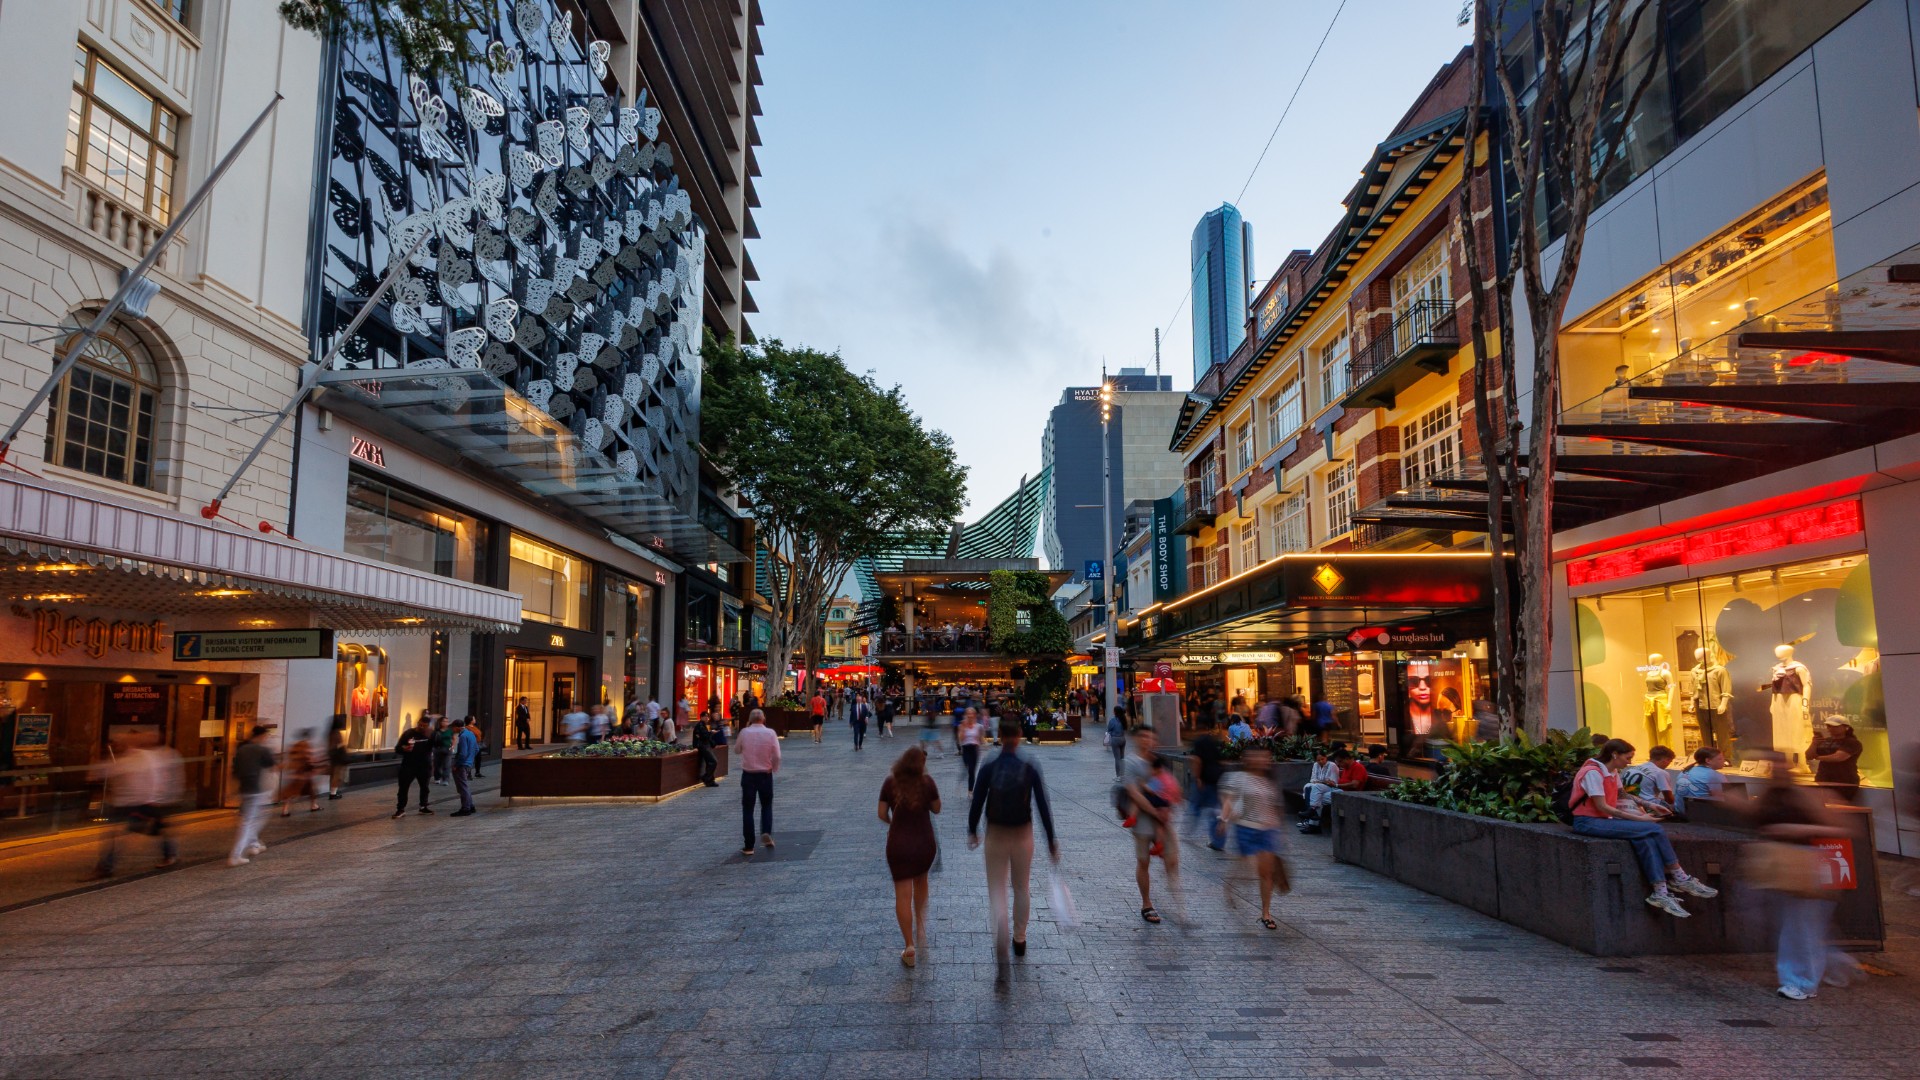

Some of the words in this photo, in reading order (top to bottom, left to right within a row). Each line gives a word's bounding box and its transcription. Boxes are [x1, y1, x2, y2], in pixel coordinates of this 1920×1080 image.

[1158, 515, 1167, 534] THE
[1159, 536, 1168, 562] BODY
[1159, 564, 1169, 590] SHOP
[32, 607, 167, 659] Regent
[1391, 632, 1429, 644] sunglass
[1430, 633, 1444, 641] hut
[205, 638, 237, 646] BRISBANE
[264, 637, 307, 645] INFORMATION
[235, 701, 254, 714] 167
[1802, 697, 1844, 710] Quality.
[1803, 711, 1815, 723] by
